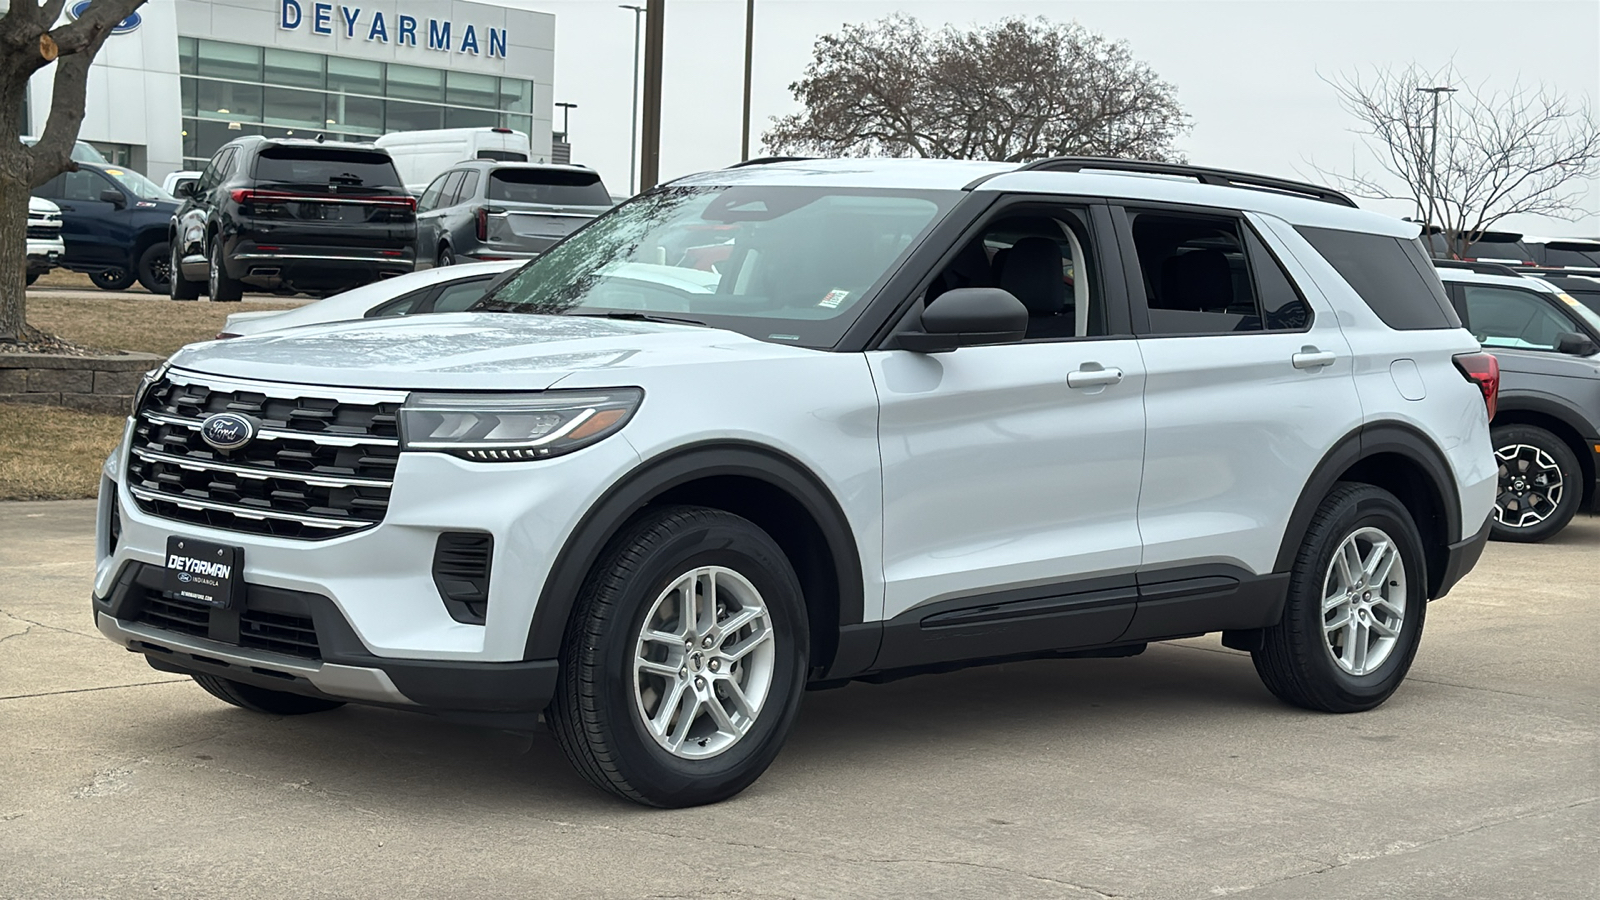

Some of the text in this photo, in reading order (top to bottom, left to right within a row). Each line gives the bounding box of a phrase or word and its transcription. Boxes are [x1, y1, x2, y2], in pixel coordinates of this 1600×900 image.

[281, 0, 507, 57] DEYARMAN
[209, 419, 239, 440] Ford
[167, 554, 231, 579] DEYARMAN
[192, 576, 219, 587] INDIANOLA
